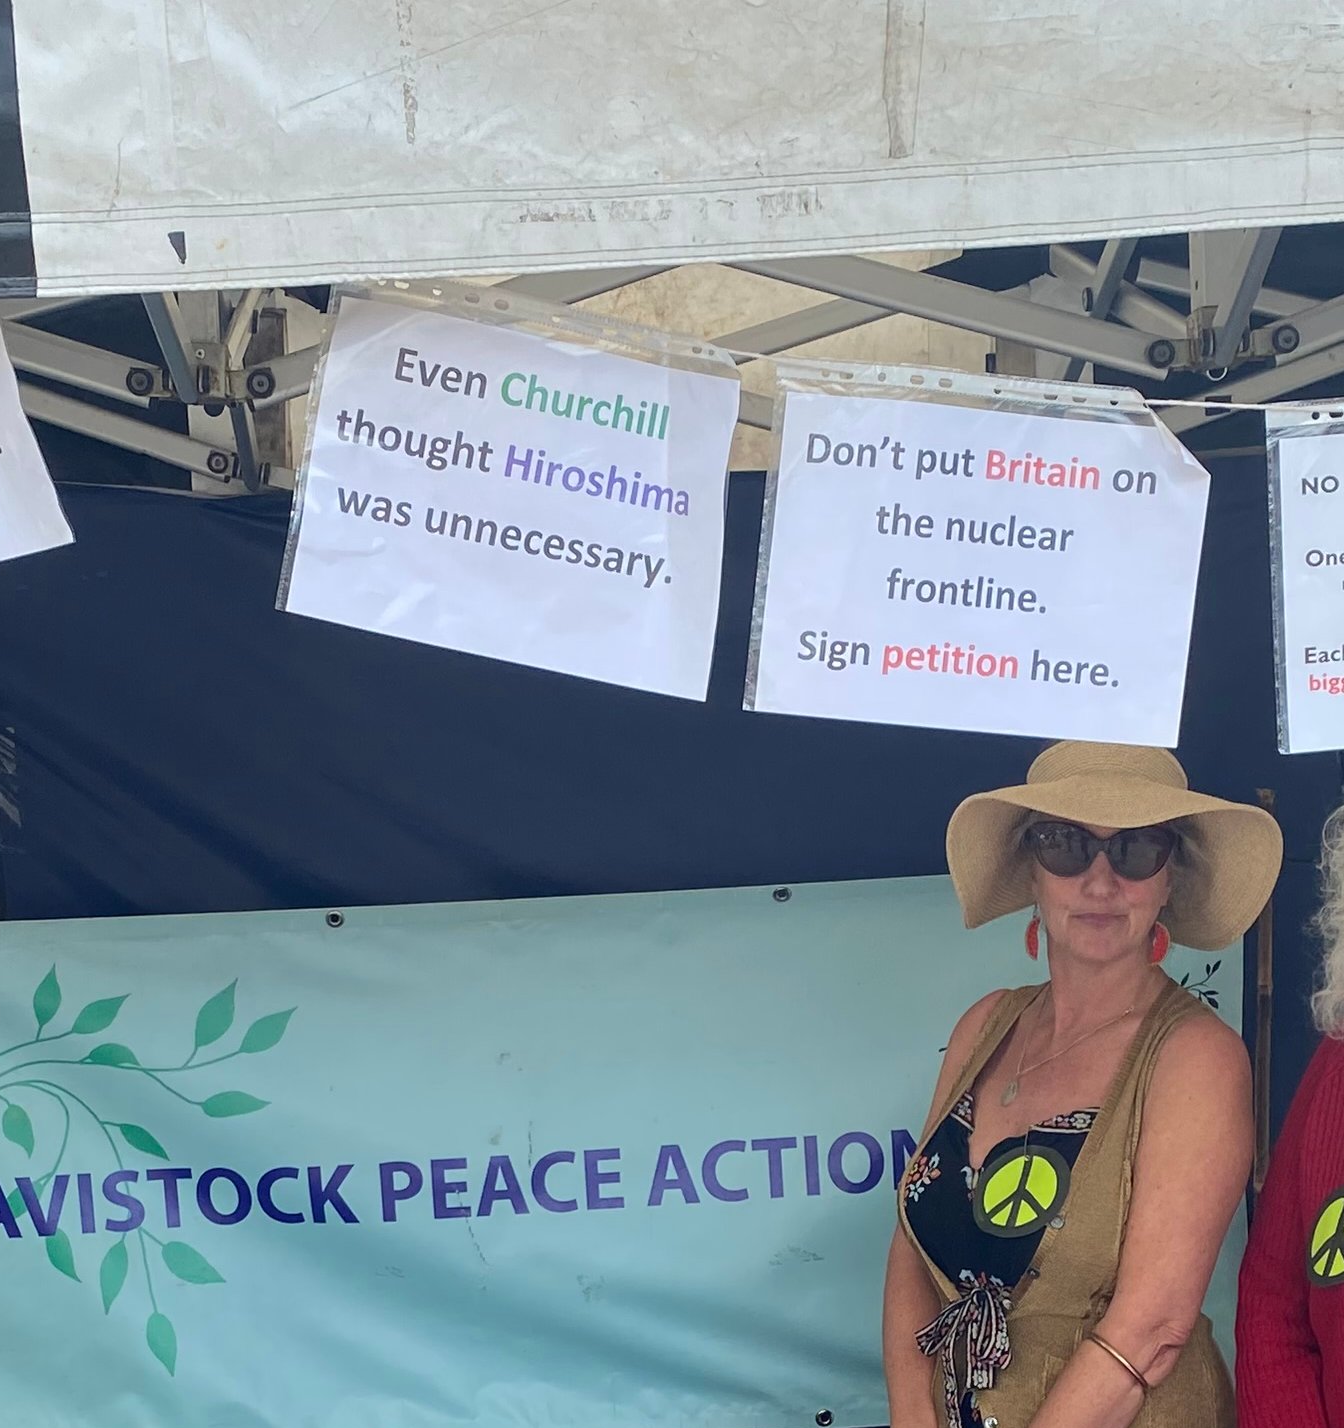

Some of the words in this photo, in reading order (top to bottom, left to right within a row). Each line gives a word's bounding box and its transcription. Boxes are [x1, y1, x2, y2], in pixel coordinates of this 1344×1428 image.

[394, 346, 488, 400] Even
[500, 372, 670, 441] Churchill
[336, 408, 494, 473] thought
[504, 444, 690, 517] Hiroshima
[915, 448, 976, 481] put
[985, 449, 1100, 491] Britain
[1112, 469, 1157, 495] on
[1301, 475, 1340, 496] NO
[337, 486, 412, 527] was
[424, 507, 672, 589] unnecessary.
[875, 502, 935, 539] the
[945, 514, 1075, 552] nuclear
[886, 567, 1047, 614] frontline.
[797, 630, 871, 671] Sign
[881, 642, 1019, 679] petition
[1030, 648, 1119, 688] here.
[379, 1147, 624, 1222] PEACE
